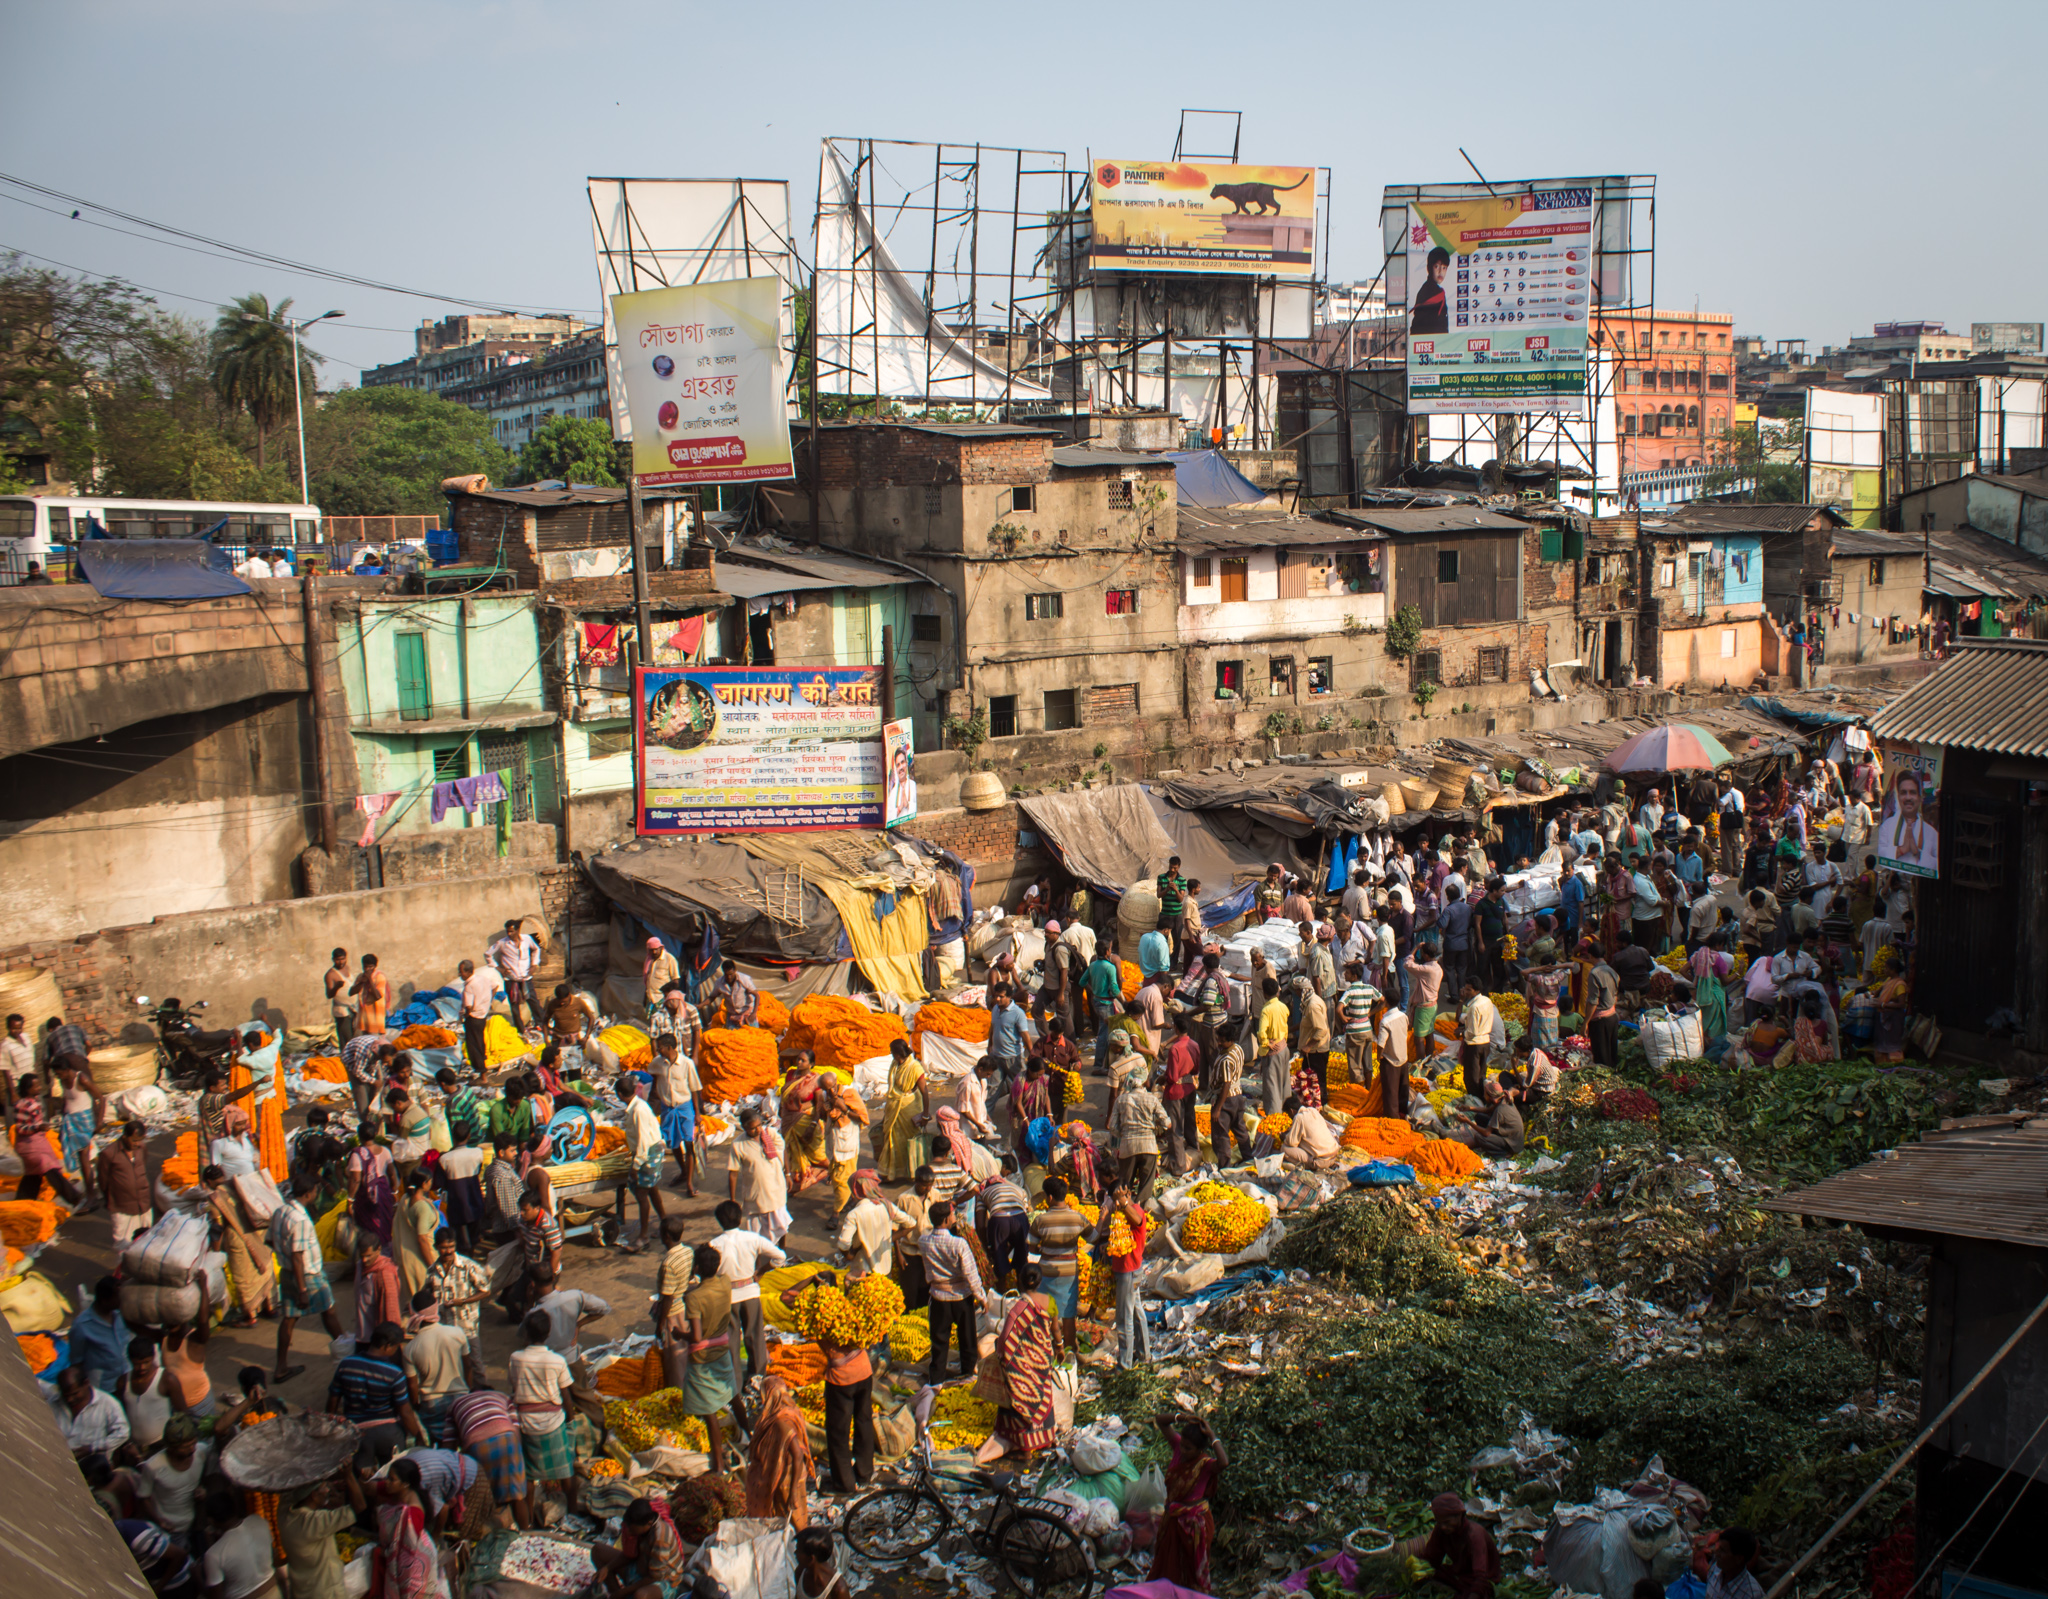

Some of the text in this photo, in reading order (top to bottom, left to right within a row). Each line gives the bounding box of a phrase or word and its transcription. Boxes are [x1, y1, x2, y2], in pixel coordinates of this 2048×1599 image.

[1125, 171, 1164, 180] PANTHER
[1536, 189, 1590, 201] NARAYANA
[1158, 198, 1164, 208] টি
[1179, 199, 1185, 208] টি
[1539, 198, 1586, 209] SCHOOLS
[1562, 224, 1587, 232] winner
[639, 322, 735, 348] সৌভাগ্য ফেরাতে
[1415, 342, 1432, 353] NTSE
[1470, 340, 1488, 350] KVPY
[1530, 338, 1545, 348] JSO
[697, 355, 737, 367] চাই আসল
[1419, 354, 1434, 366] 33%
[1474, 352, 1490, 364] 35%
[1531, 350, 1549, 362] 42%
[1442, 376, 1460, 385] (033)
[1462, 375, 1479, 383] 4003
[1480, 375, 1498, 383] 4647
[1504, 374, 1525, 383] 4748,
[1527, 373, 1545, 381] 4000
[681, 375, 739, 400] গ্রহরত্ন
[708, 401, 737, 414] ও সঠিক
[683, 415, 740, 430] জ্যোতিষ পরামর্শ
[671, 448, 689, 462] সেন
[1857, 493, 1878, 505] Brough
[713, 674, 874, 704] जागरण की रात
[722, 707, 875, 721] आयोजक मनोकामना मन्दिर समिती
[765, 725, 787, 734] लोहा
[791, 725, 819, 734] गोदाम
[823, 727, 841, 735] फूल
[752, 743, 820, 753] आमंत्रित कलाकार
[802, 754, 825, 763] प्रियंका
[829, 755, 846, 765] गुप्ता
[1891, 751, 1937, 772] সন্তোষ
[794, 765, 815, 773] राकेश
[703, 779, 718, 787] नृत्य
[721, 776, 747, 784] नाटिका
